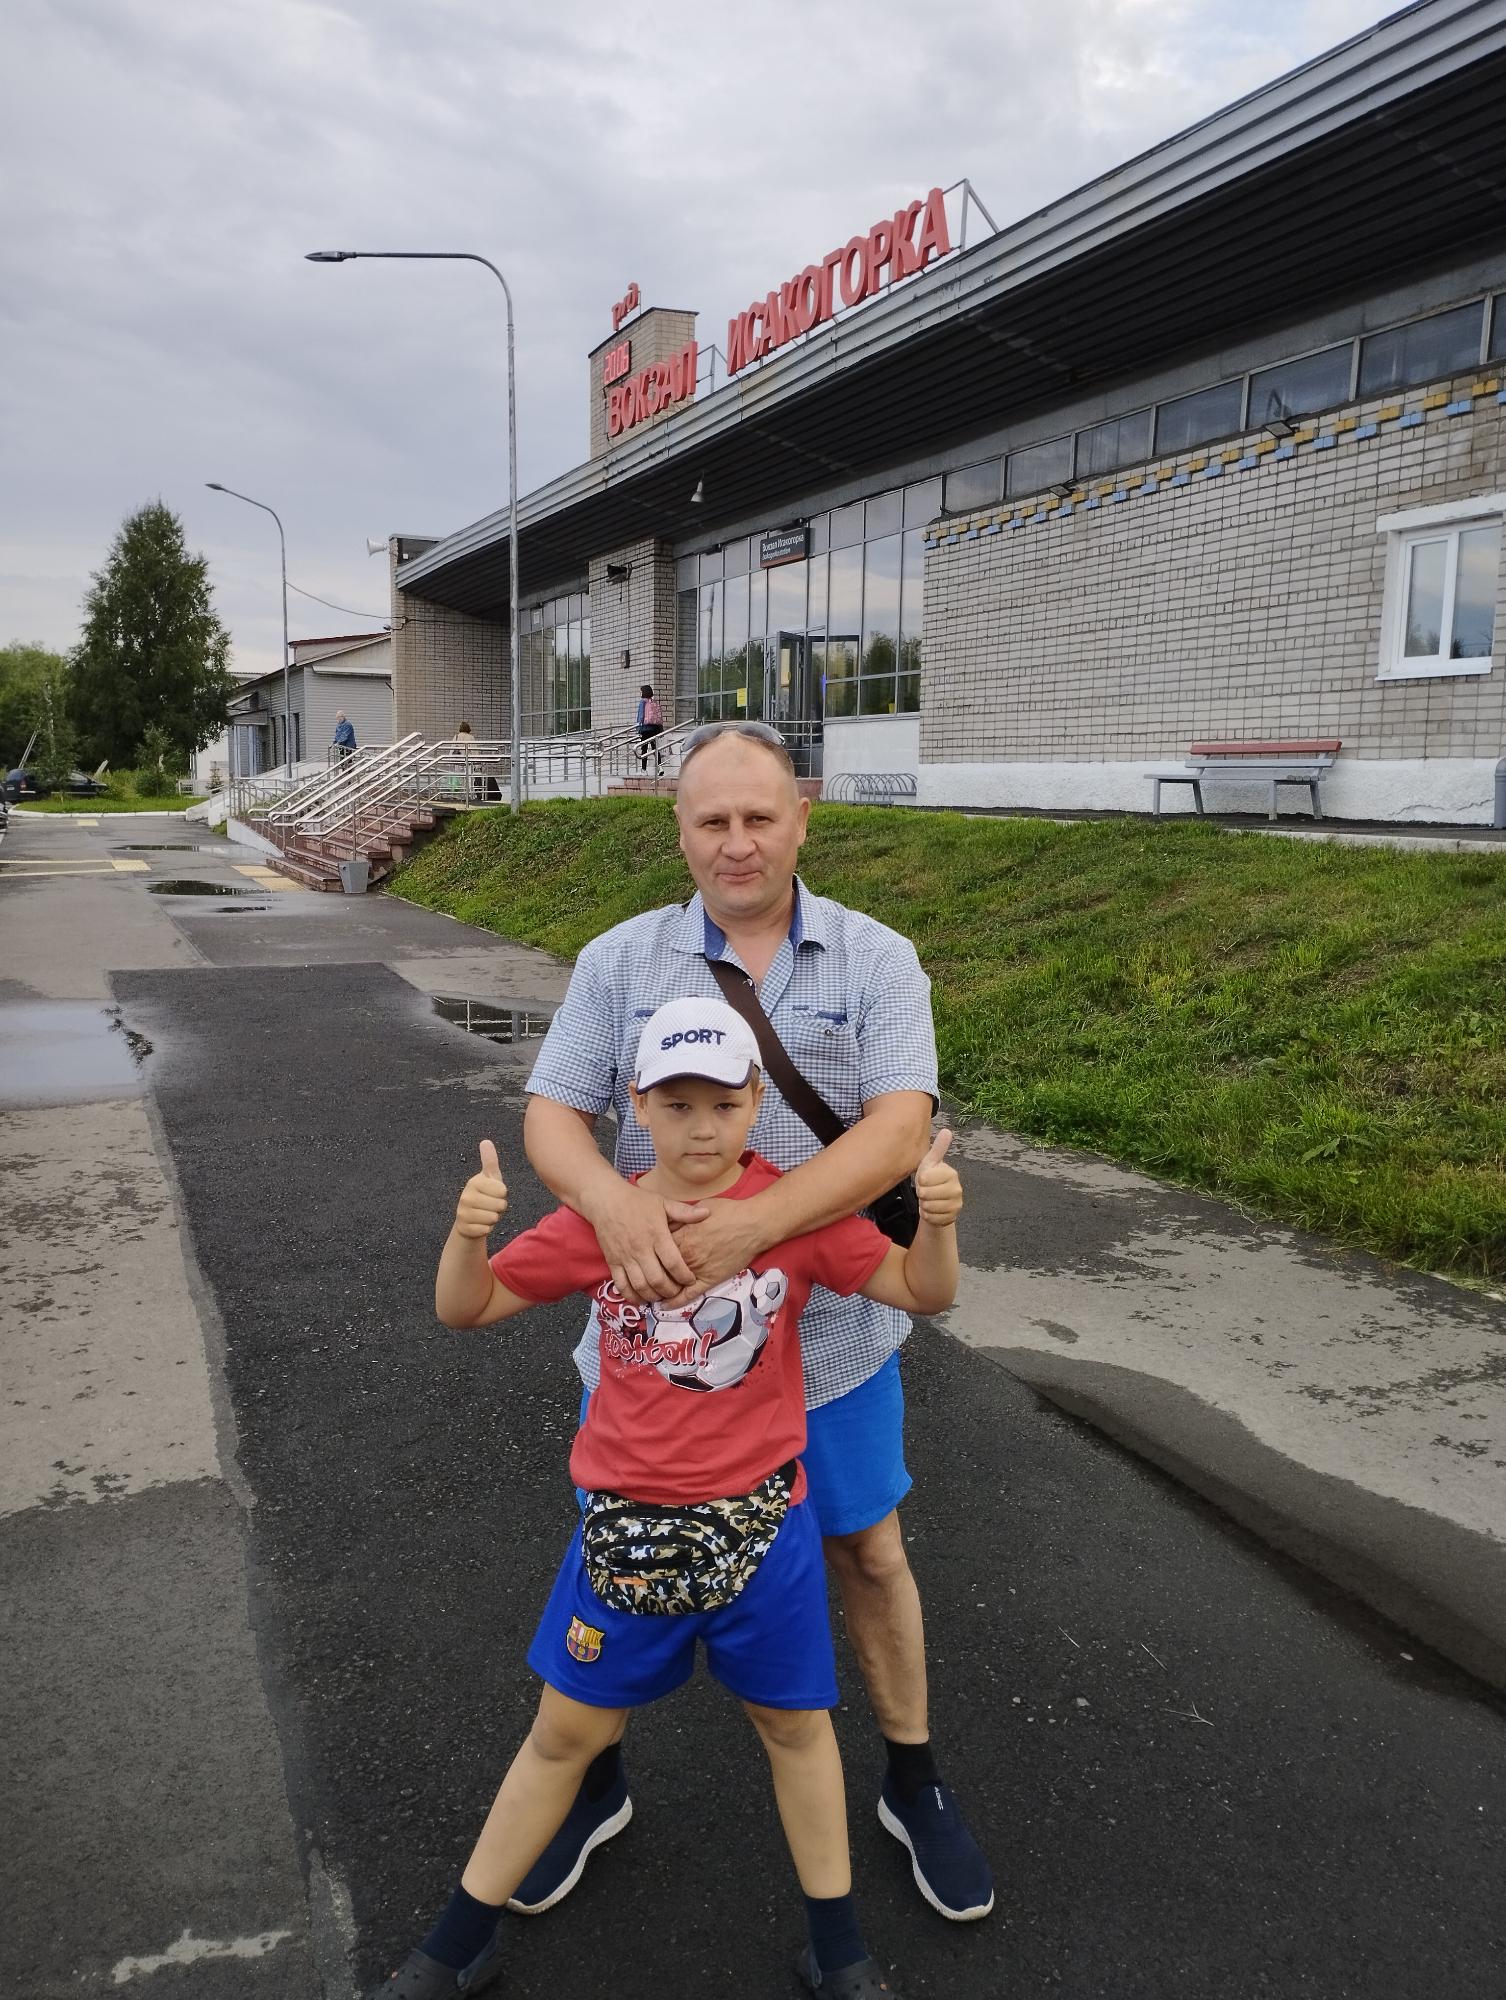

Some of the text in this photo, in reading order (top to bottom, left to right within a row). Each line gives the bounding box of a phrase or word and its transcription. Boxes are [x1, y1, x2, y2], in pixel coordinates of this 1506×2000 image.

[608, 187, 951, 437] ВОКЗАЛ ИСАКОГОРКА
[661, 1028, 726, 1051] SPORT
